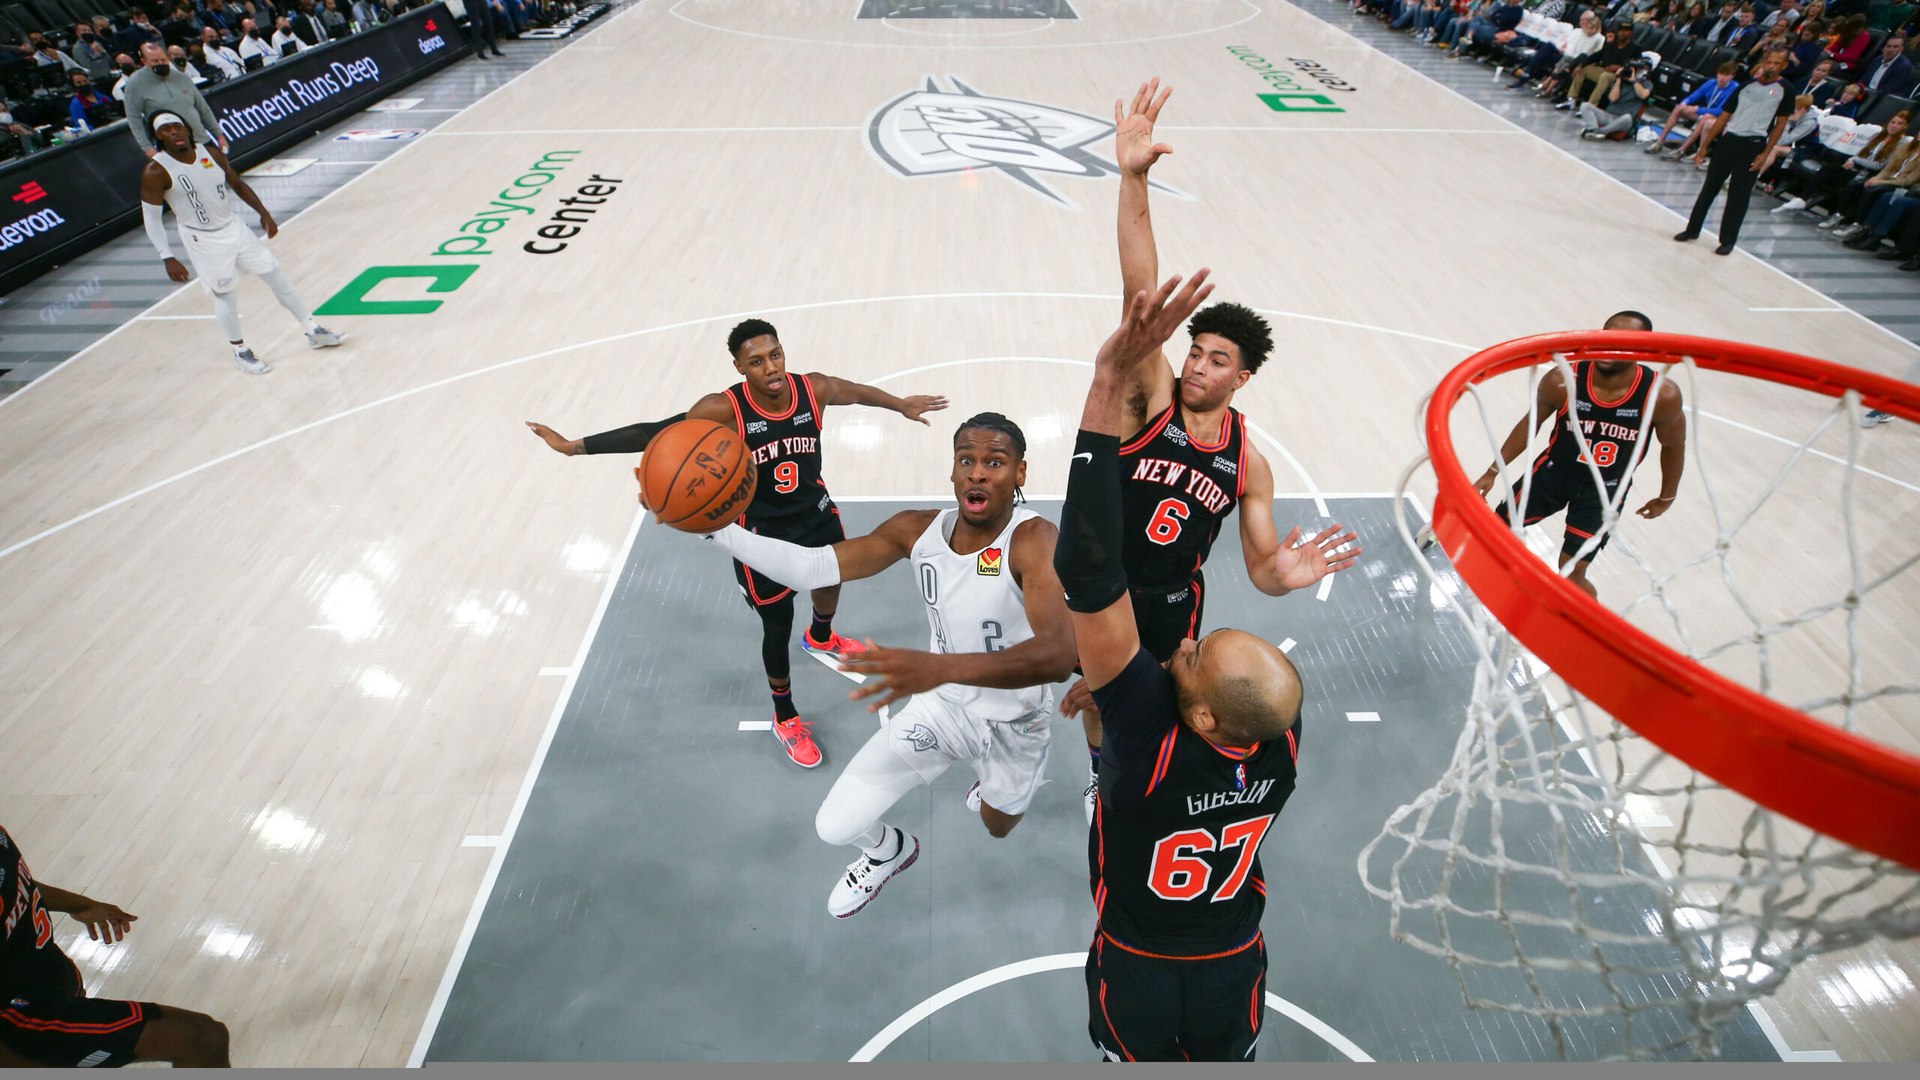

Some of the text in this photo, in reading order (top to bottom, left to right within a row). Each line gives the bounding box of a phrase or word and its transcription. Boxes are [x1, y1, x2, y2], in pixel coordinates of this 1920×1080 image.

[1226, 45, 1317, 91] paycom
[1286, 56, 1357, 92] center
[205, 56, 380, 147] mitment Runs Deep
[178, 174, 209, 225] OKC
[217, 184, 226, 200] 5
[430, 150, 582, 256] paycom
[523, 174, 623, 254] center
[792, 411, 811, 421] SQUARE
[1566, 420, 1640, 442] NW YORK
[782, 437, 817, 455] YORK
[1214, 456, 1237, 470] SQUARE
[774, 461, 799, 494] 9
[1131, 458, 1230, 515] NEW YORK
[1212, 461, 1233, 474] SPACE
[1145, 497, 1190, 546] 6
[982, 620, 1005, 653] 2
[1147, 813, 1276, 903] 67
[32, 887, 52, 949] 5
